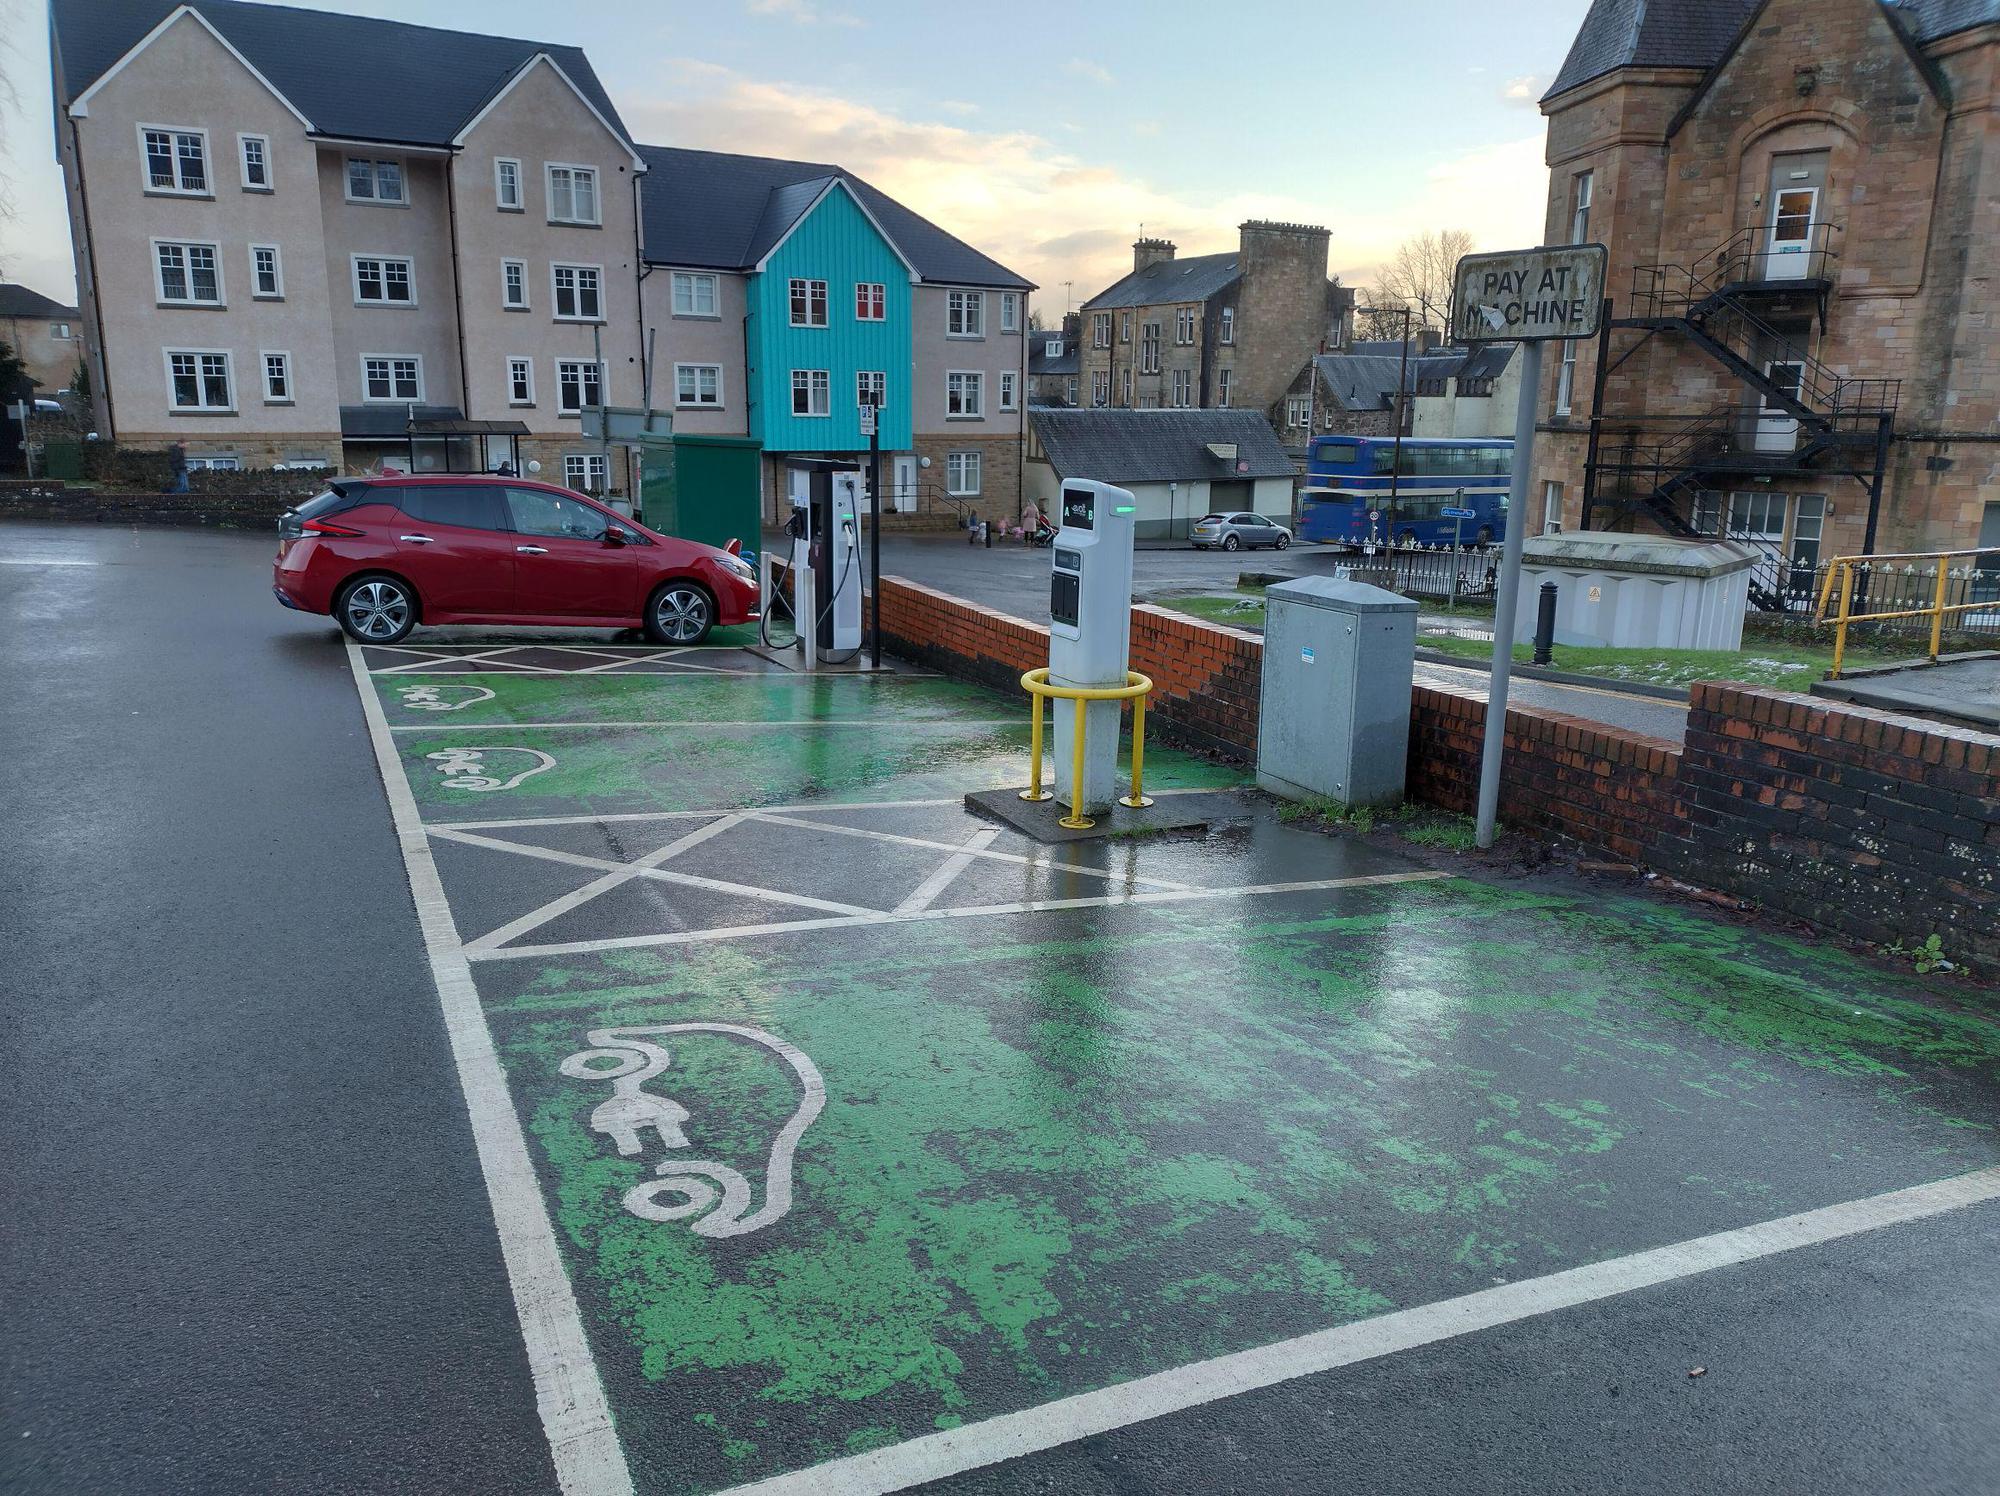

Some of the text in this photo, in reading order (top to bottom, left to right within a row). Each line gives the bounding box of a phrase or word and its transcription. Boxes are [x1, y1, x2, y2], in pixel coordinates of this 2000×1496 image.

[1484, 266, 1571, 295] PAY AT
[1064, 506, 1069, 517] A
[1088, 510, 1093, 520] B
